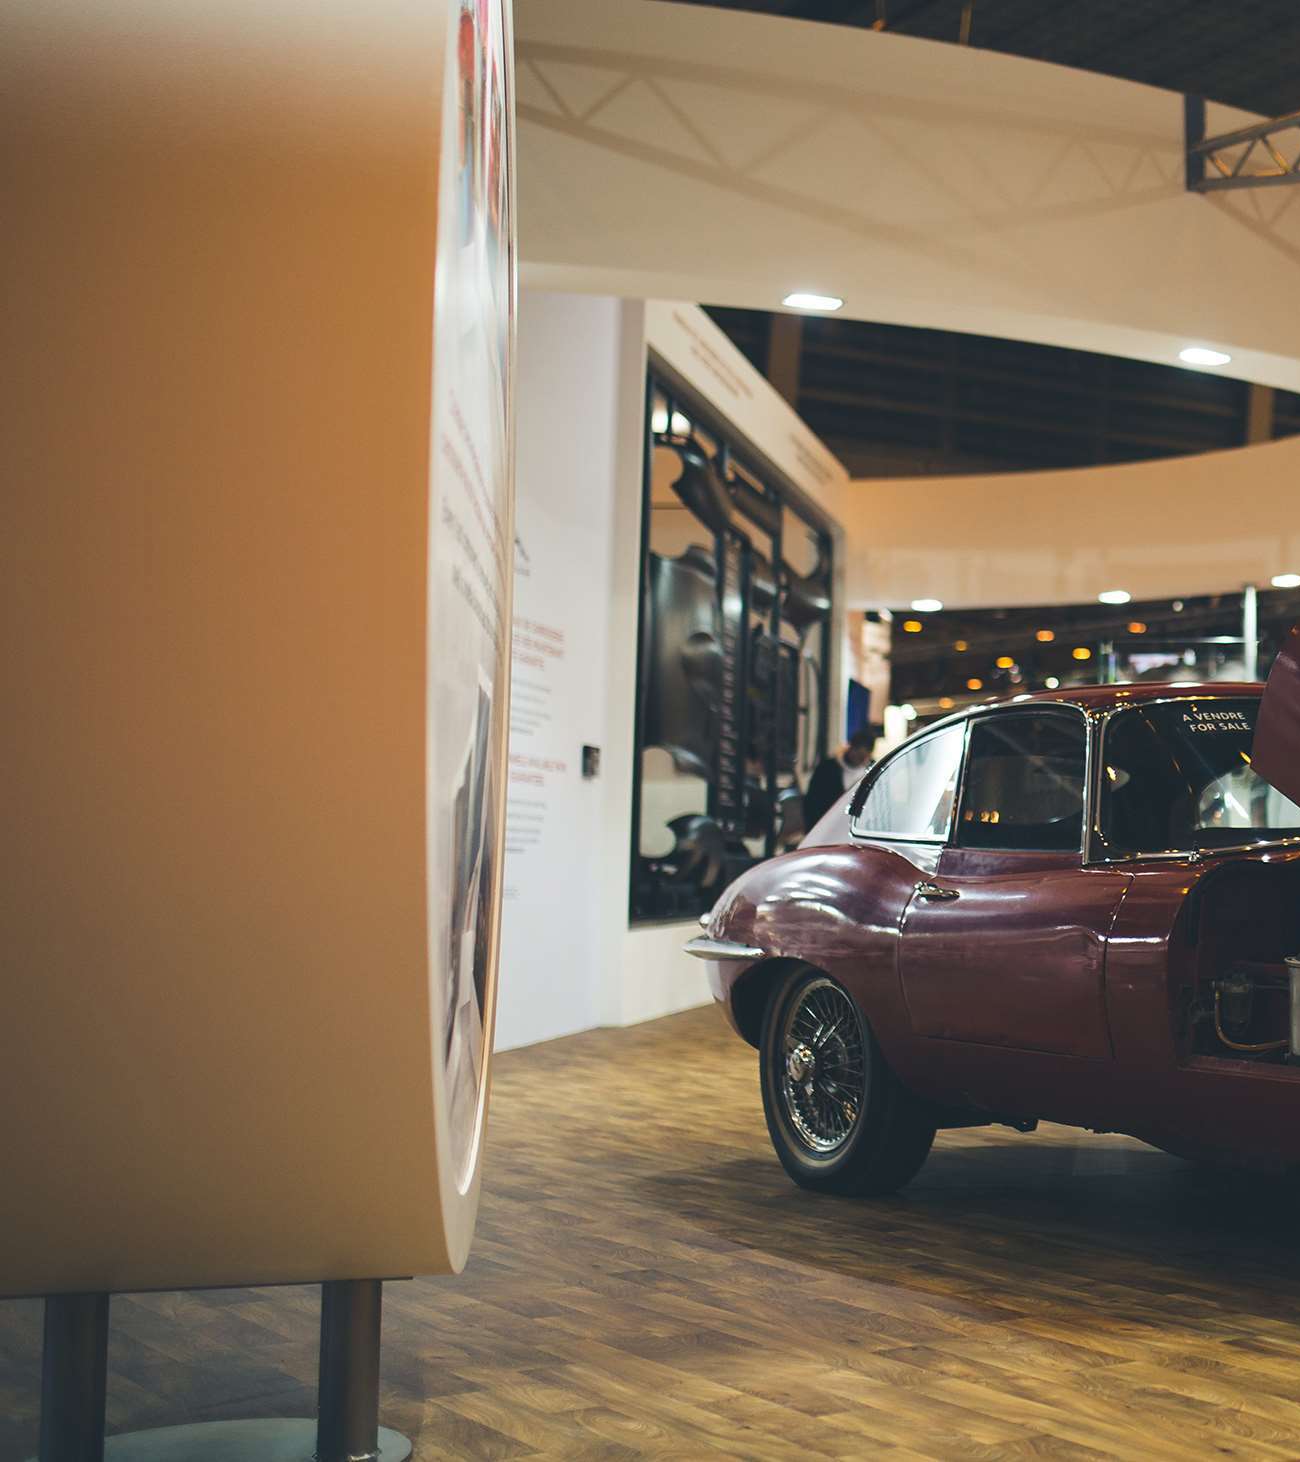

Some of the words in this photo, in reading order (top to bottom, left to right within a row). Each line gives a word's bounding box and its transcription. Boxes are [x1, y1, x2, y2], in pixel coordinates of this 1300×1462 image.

[1183, 714, 1192, 722] A
[1194, 711, 1246, 721] VENDRE
[1190, 722, 1216, 732] FOR
[1219, 722, 1251, 731] SALE
